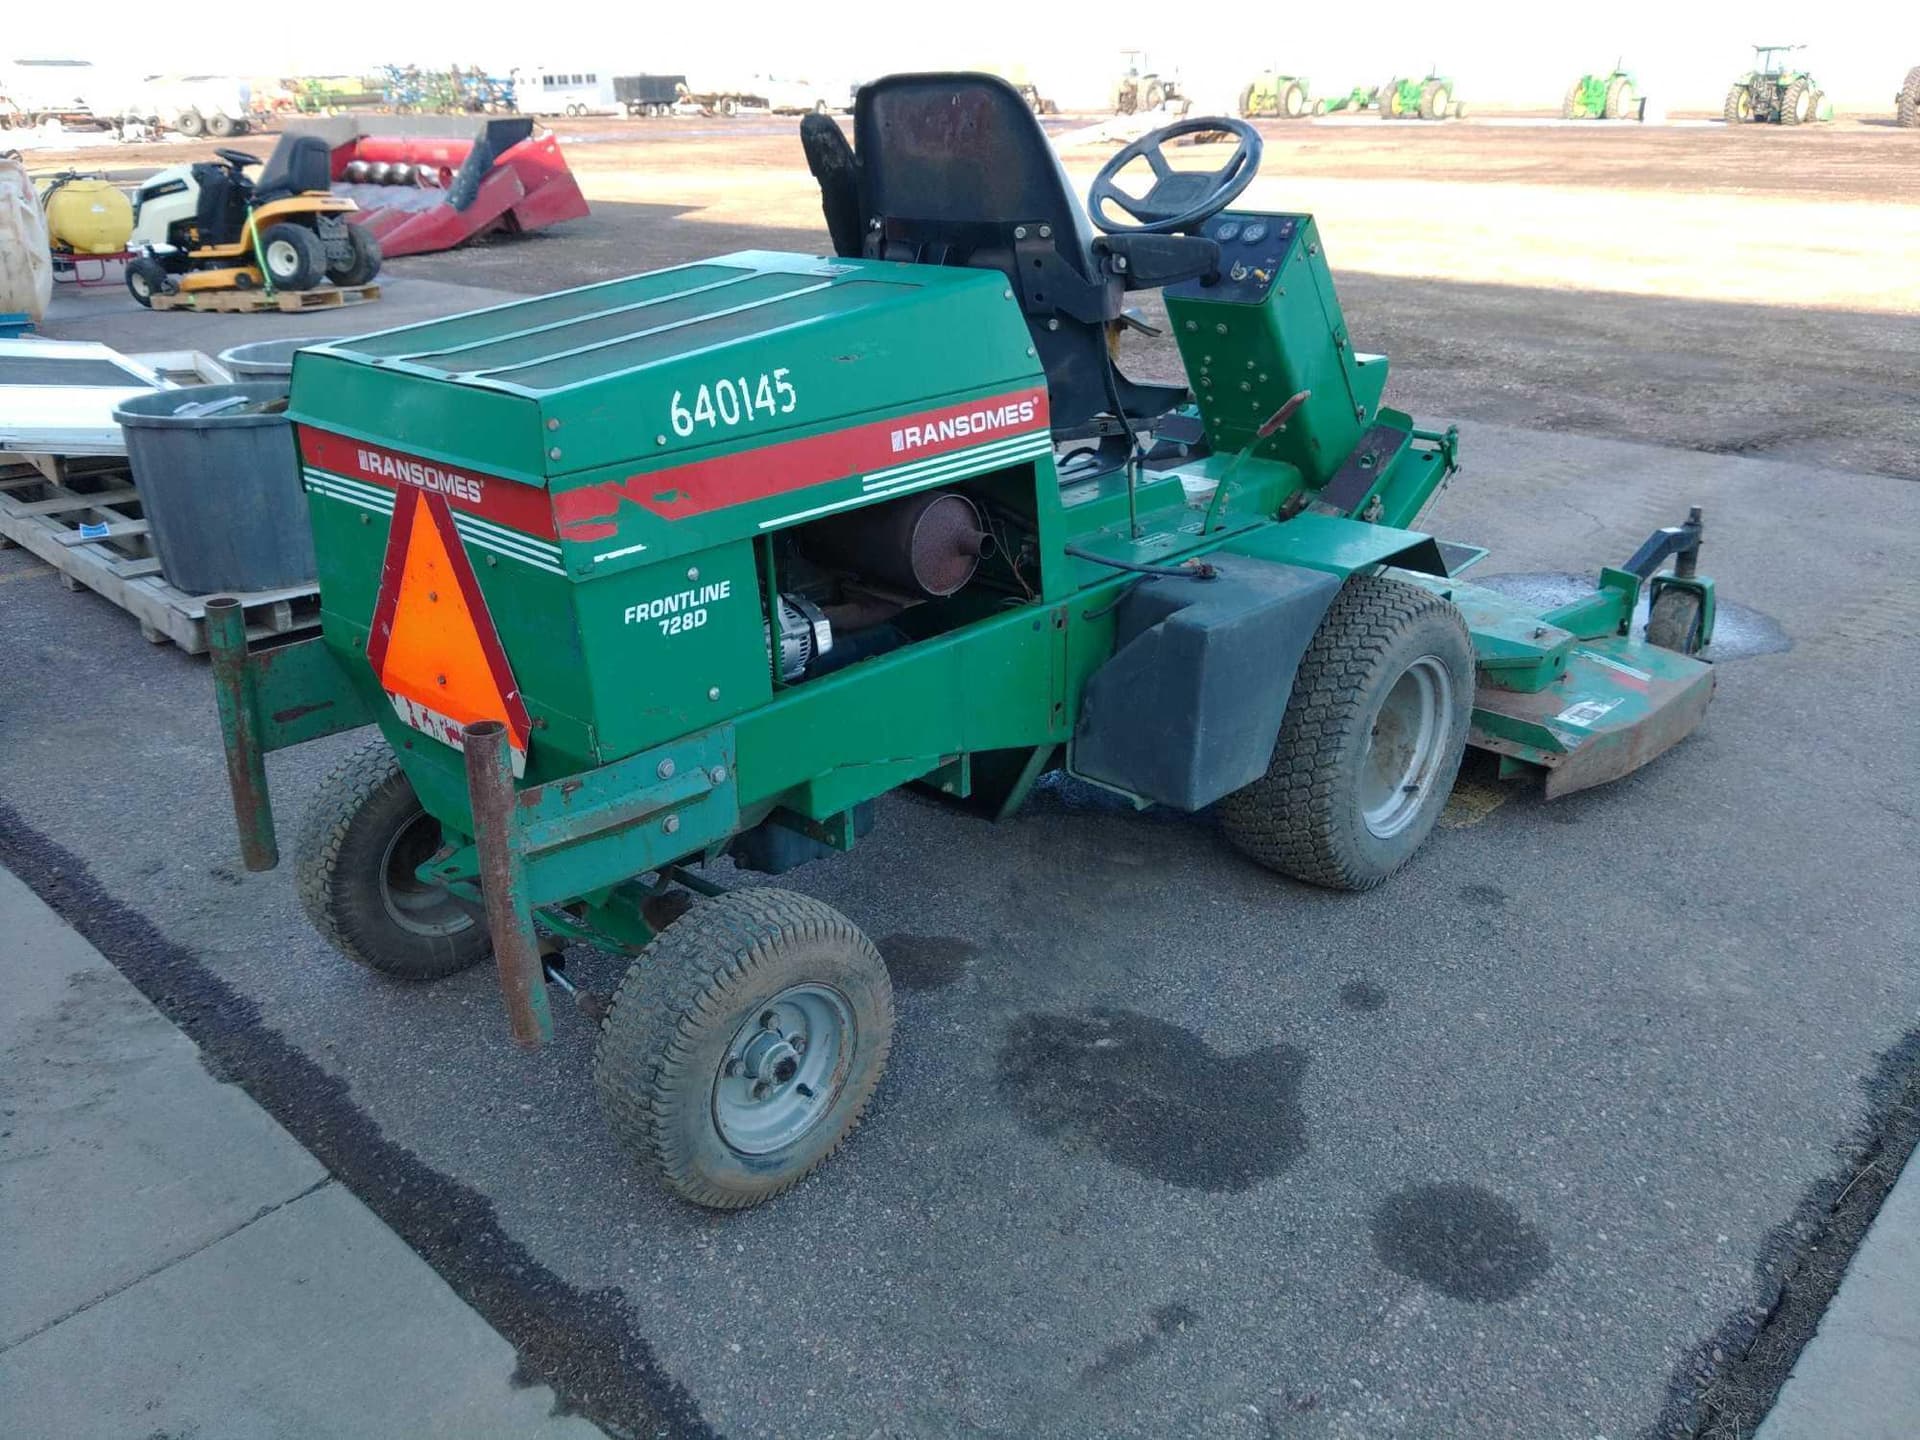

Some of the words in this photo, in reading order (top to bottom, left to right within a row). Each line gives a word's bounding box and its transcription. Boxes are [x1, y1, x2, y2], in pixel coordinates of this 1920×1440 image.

[671, 368, 797, 437] 640145
[905, 401, 1034, 449] RANSOMES
[368, 452, 482, 503] RANSOMES
[624, 580, 731, 625] FRONTLINE
[658, 608, 708, 636] 728D
